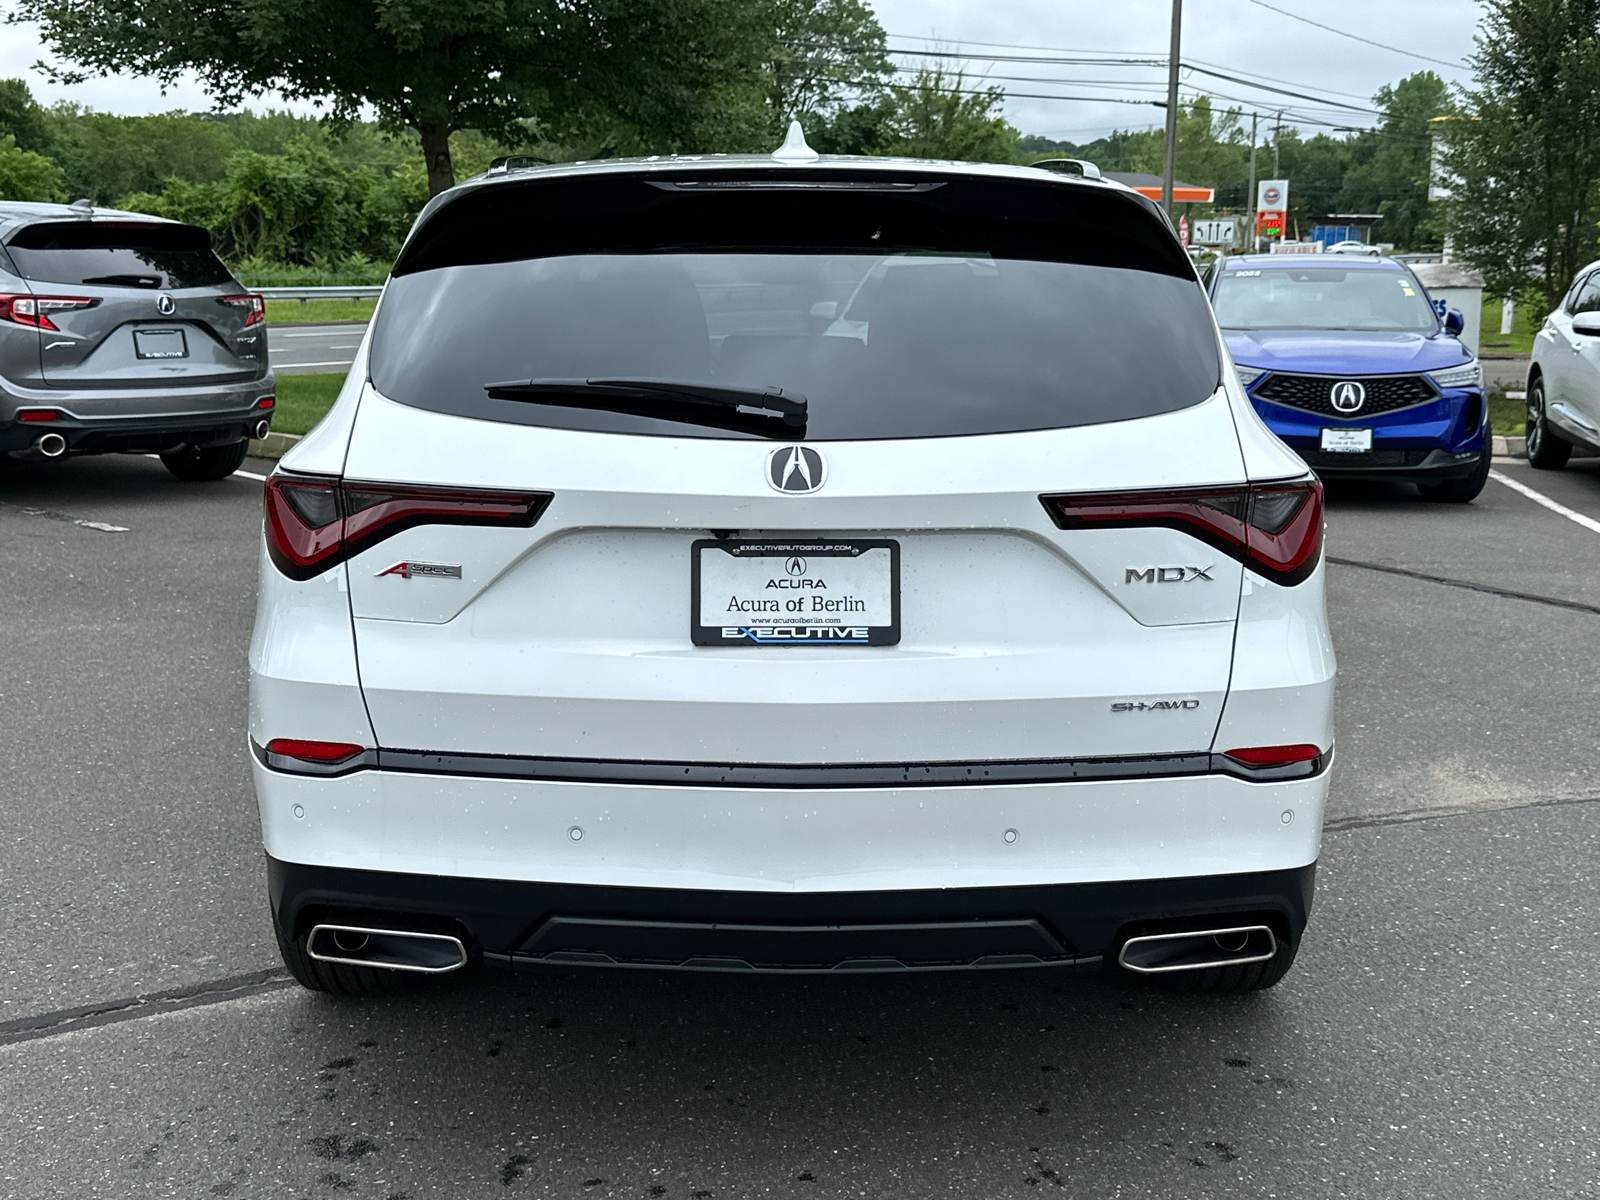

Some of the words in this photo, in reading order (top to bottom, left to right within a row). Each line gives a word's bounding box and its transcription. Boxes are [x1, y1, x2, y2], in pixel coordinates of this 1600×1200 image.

[1125, 563, 1215, 584] MDX
[765, 579, 827, 589] ACURA
[726, 596, 780, 612] Acura
[786, 597, 805, 612] of
[811, 595, 866, 612] Berlin
[721, 627, 869, 641] EXECUTIVE
[1110, 699, 1200, 711] SH-AWD
